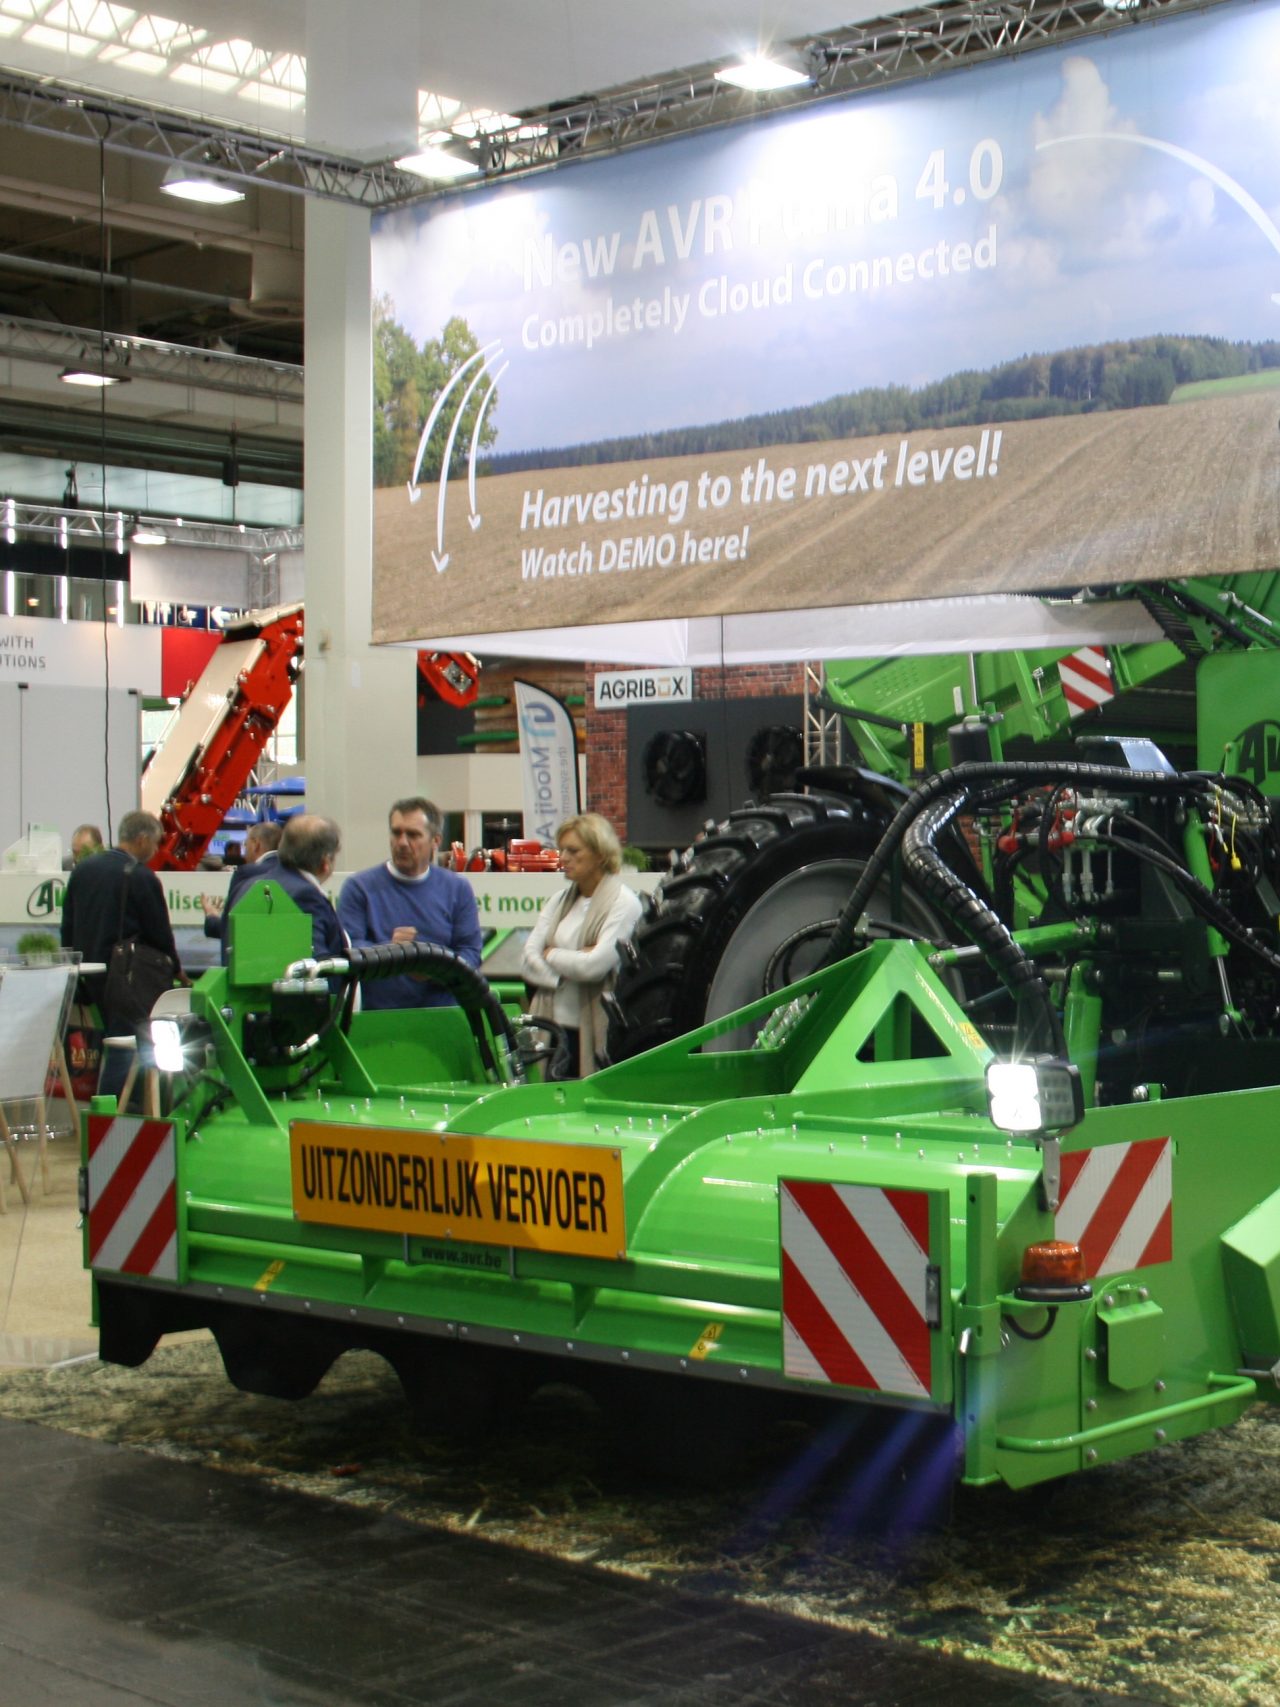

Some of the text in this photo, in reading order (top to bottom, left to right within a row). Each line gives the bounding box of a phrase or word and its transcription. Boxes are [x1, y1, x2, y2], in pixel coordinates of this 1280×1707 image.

[522, 232, 620, 292] New
[632, 194, 734, 270] AVR
[915, 138, 1004, 209] 4.0
[521, 223, 997, 349] Completely Cloud Connected
[520, 429, 1003, 530] Harvesting to the next level!
[521, 525, 750, 580] Watch DEMO here!
[600, 675, 684, 700] AGRIBOX
[498, 896, 551, 912] mor
[301, 1144, 608, 1233] UITZONDERLIJK VERVOER
[421, 1246, 503, 1269] www.avr.be
